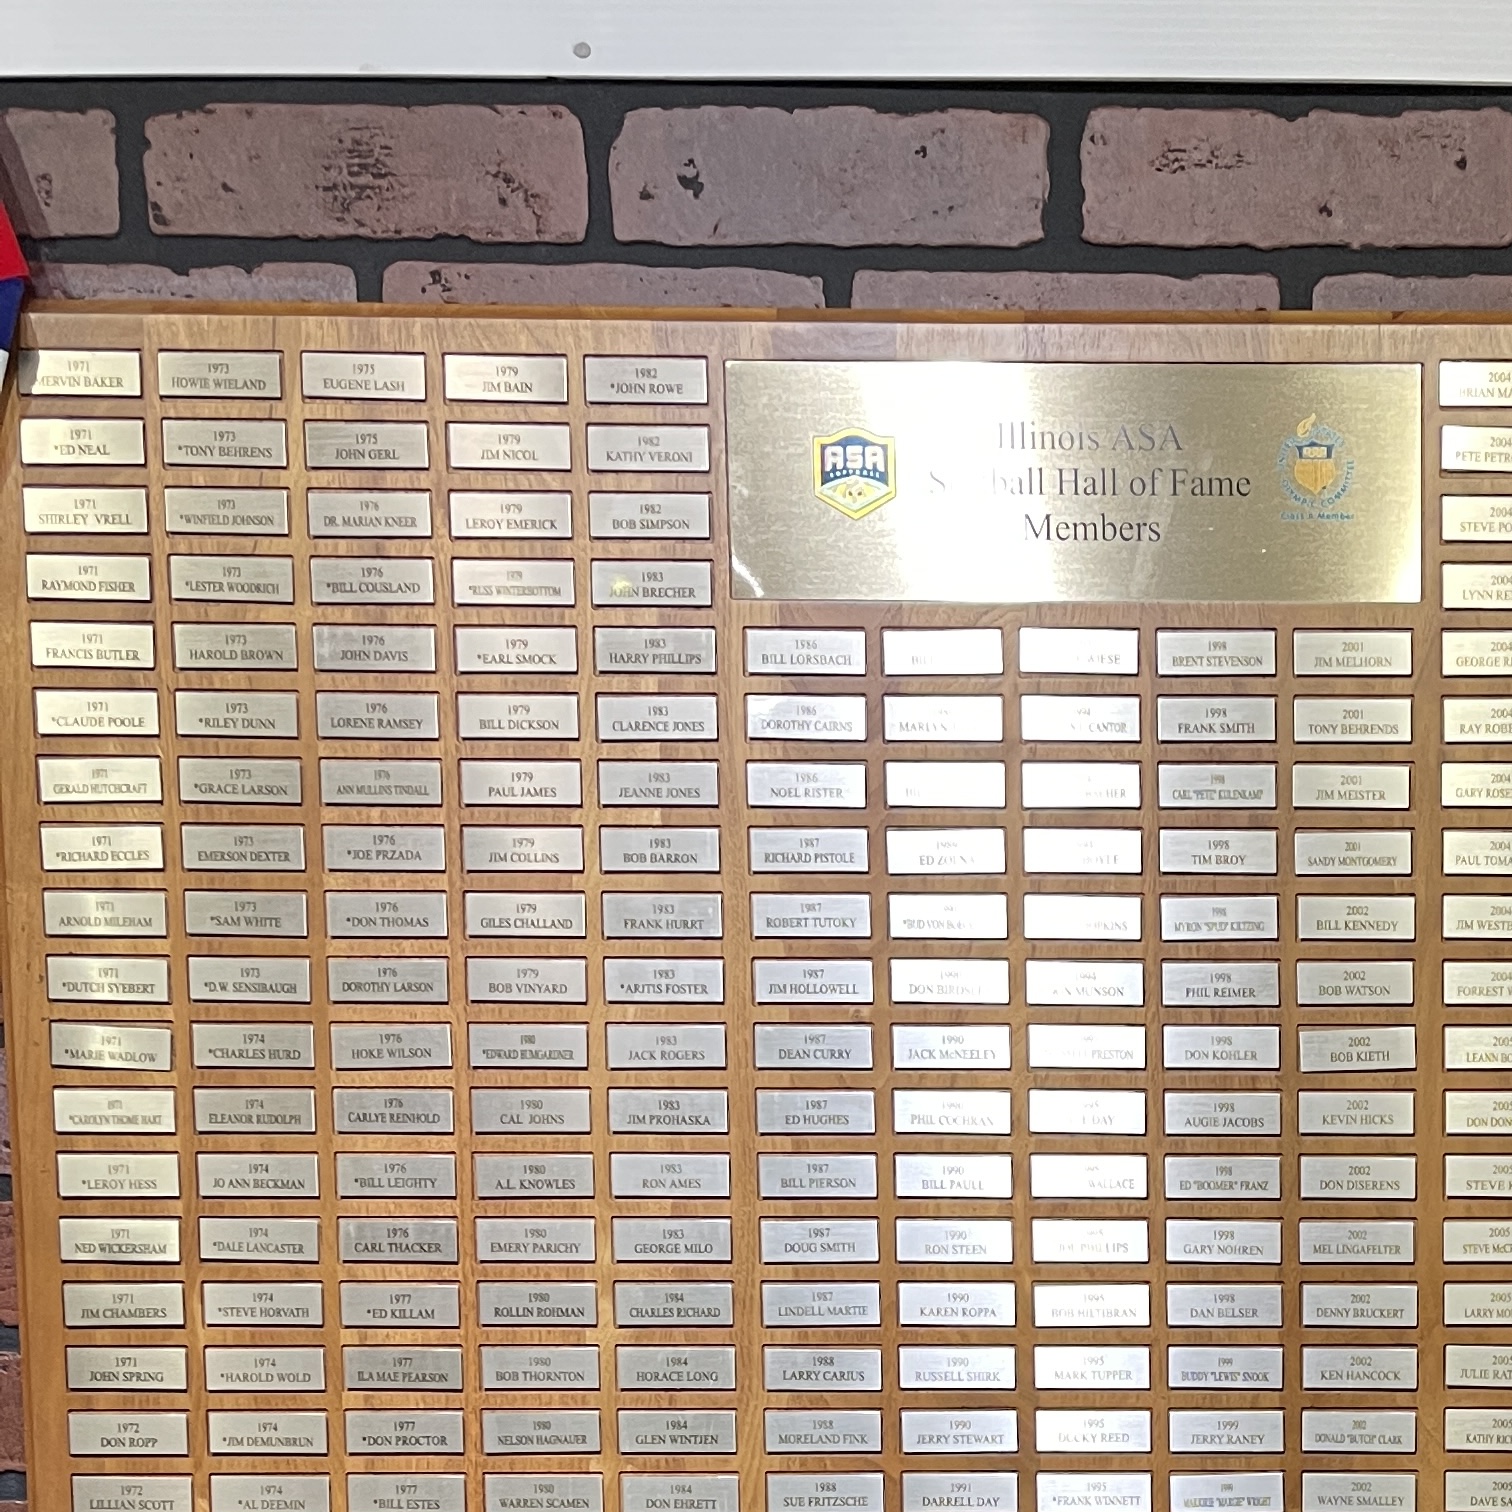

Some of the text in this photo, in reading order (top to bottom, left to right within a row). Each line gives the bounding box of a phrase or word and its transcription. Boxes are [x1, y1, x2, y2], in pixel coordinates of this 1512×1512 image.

[208, 363, 229, 373] 1973
[172, 378, 266, 389] HOWIE WIELAND
[355, 433, 378, 445] 1975
[998, 421, 1183, 450] Illinois ASA
[335, 449, 400, 460] JOHN GERL
[824, 445, 885, 472] ASA
[1056, 467, 1117, 497] Hall
[1129, 467, 1163, 497] of
[1170, 468, 1251, 498] Fame
[501, 504, 522, 513] 1979
[640, 504, 661, 514] 1982
[466, 519, 557, 529] LEROY EMERICK
[613, 519, 689, 529] BOB SIMPSON
[1024, 512, 1161, 542] Members
[225, 634, 247, 645] 1973
[189, 650, 283, 660] HAROLD BROWN
[1206, 708, 1227, 718] 1998
[1178, 723, 1255, 733] FRANK SMITH
[800, 838, 819, 848] 1987
[765, 853, 854, 863] RICHARD PISTOLE
[1346, 906, 1368, 915] 2002
[1317, 920, 1398, 931] BILL KENNEDY
[378, 968, 397, 977] 1976
[342, 982, 433, 992] DOROTHY LARSON
[387, 1228, 409, 1238] 1976
[809, 1228, 830, 1238] 1987
[354, 1243, 442, 1253] CARL THACKER
[785, 1243, 855, 1252] DOUG SMITH
[529, 1357, 551, 1366] 1980
[667, 1357, 688, 1366] 1984
[1350, 1356, 1372, 1366] 2002
[496, 1371, 584, 1381] BOB THORNTON
[637, 1371, 718, 1381] HORACE LONG
[1321, 1371, 1401, 1380] KEN HANCOCK
[951, 1483, 971, 1492] 1991
[923, 1497, 1000, 1507] DARRELL DAY
